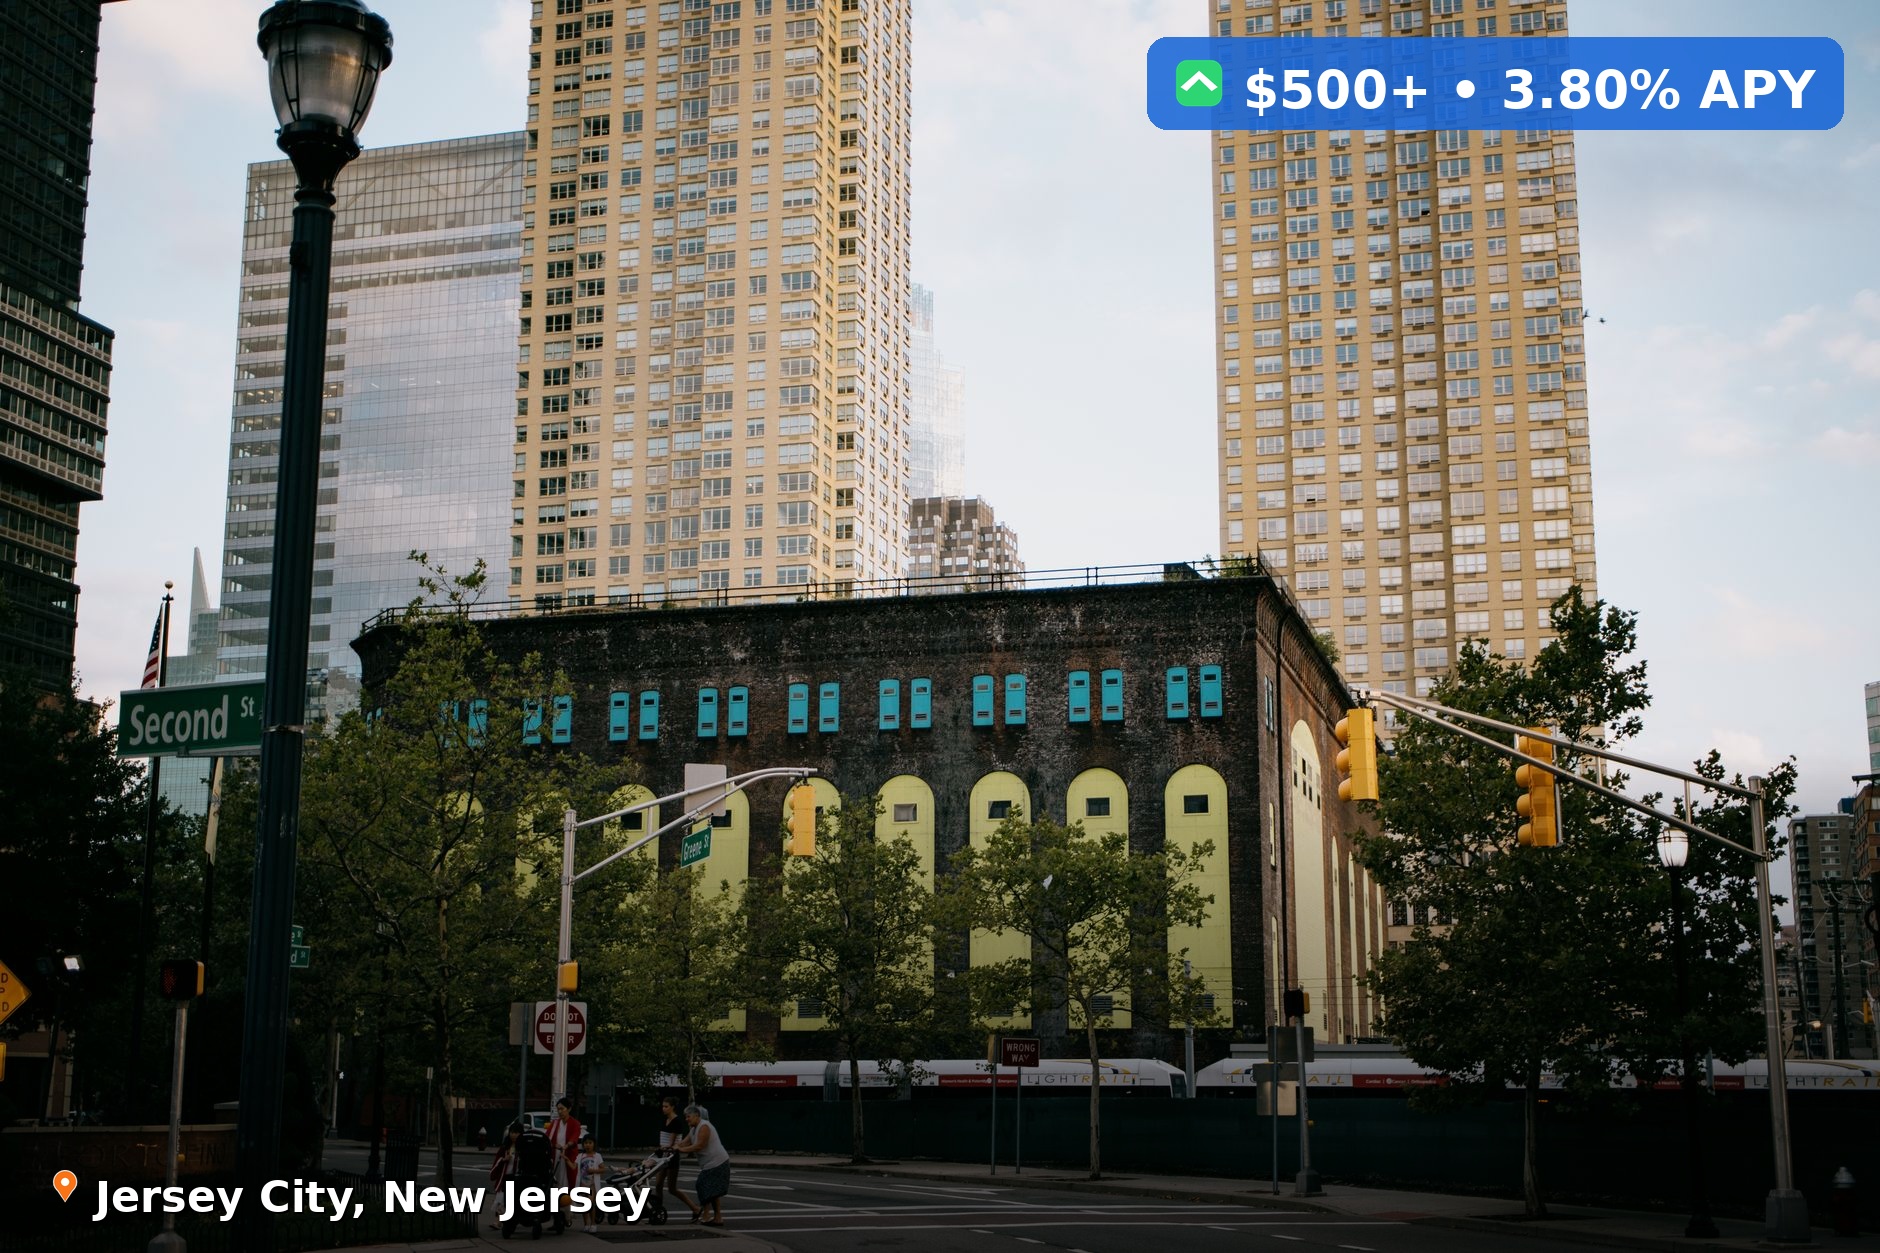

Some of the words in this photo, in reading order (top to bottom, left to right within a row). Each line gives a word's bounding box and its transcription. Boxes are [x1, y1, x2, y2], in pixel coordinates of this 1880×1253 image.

[128, 694, 229, 747] Second
[240, 696, 255, 718] St
[684, 840, 702, 861] Greene
[1006, 1042, 1036, 1052] WRONG
[1011, 1053, 1029, 1063] WAY
